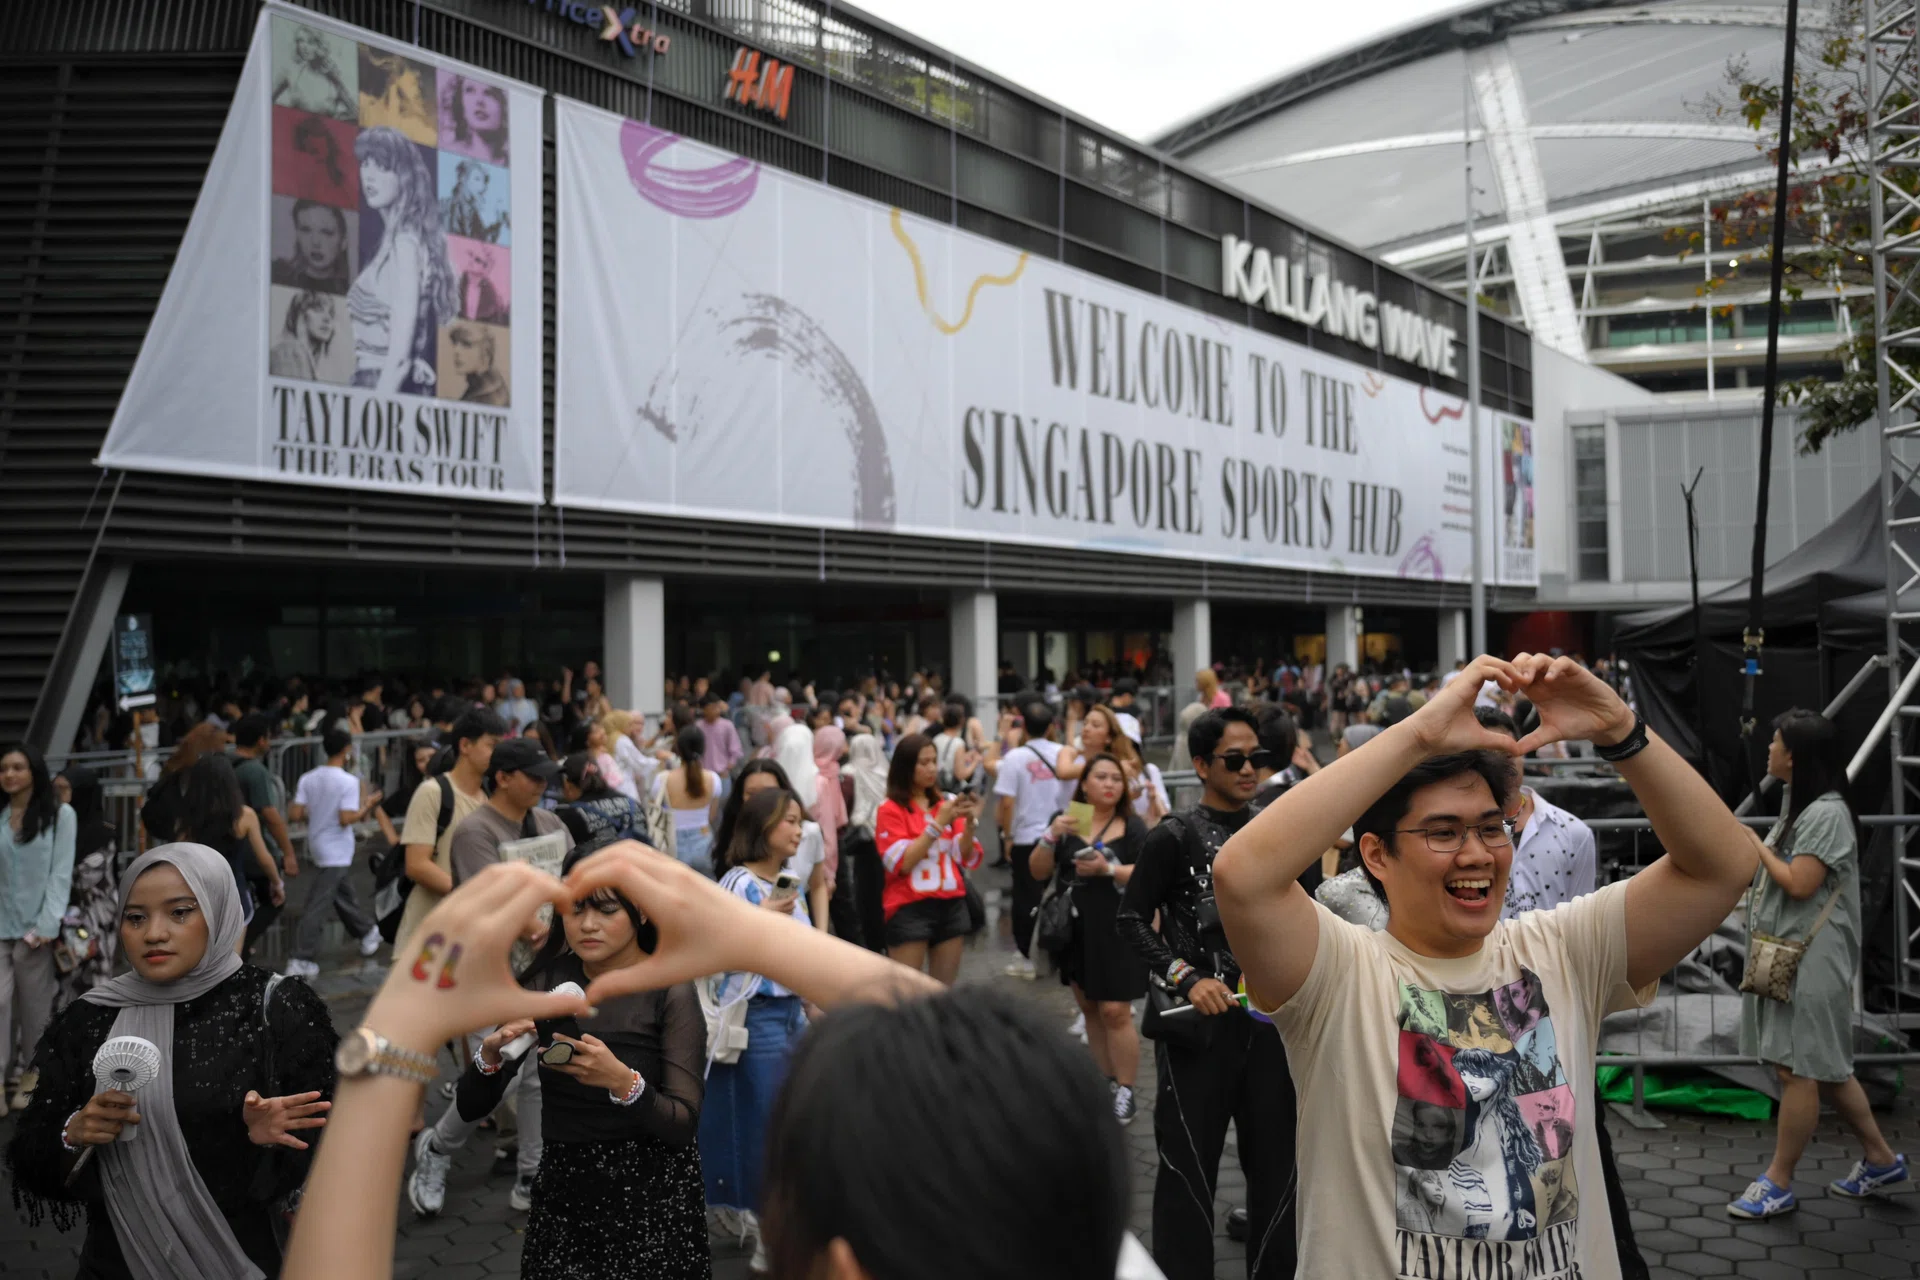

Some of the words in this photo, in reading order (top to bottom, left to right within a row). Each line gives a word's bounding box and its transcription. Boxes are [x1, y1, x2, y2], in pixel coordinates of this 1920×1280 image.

[1221, 233, 1379, 349] KALLANG
[1380, 301, 1458, 378] WAVE
[272, 386, 405, 454] TAYLOR
[414, 404, 508, 464] SWIFT
[1044, 288, 1233, 427] WELCOME
[1248, 353, 1287, 438] TO
[1301, 369, 1357, 455] THE
[273, 445, 338, 476] THE
[349, 452, 424, 484] ERAS
[433, 462, 505, 491] TOUR
[962, 406, 1203, 534] SINGAPORE
[1220, 457, 1333, 551] SPORTS
[1348, 480, 1404, 557] HUB
[1395, 1228, 1514, 1280] TAYLOR
